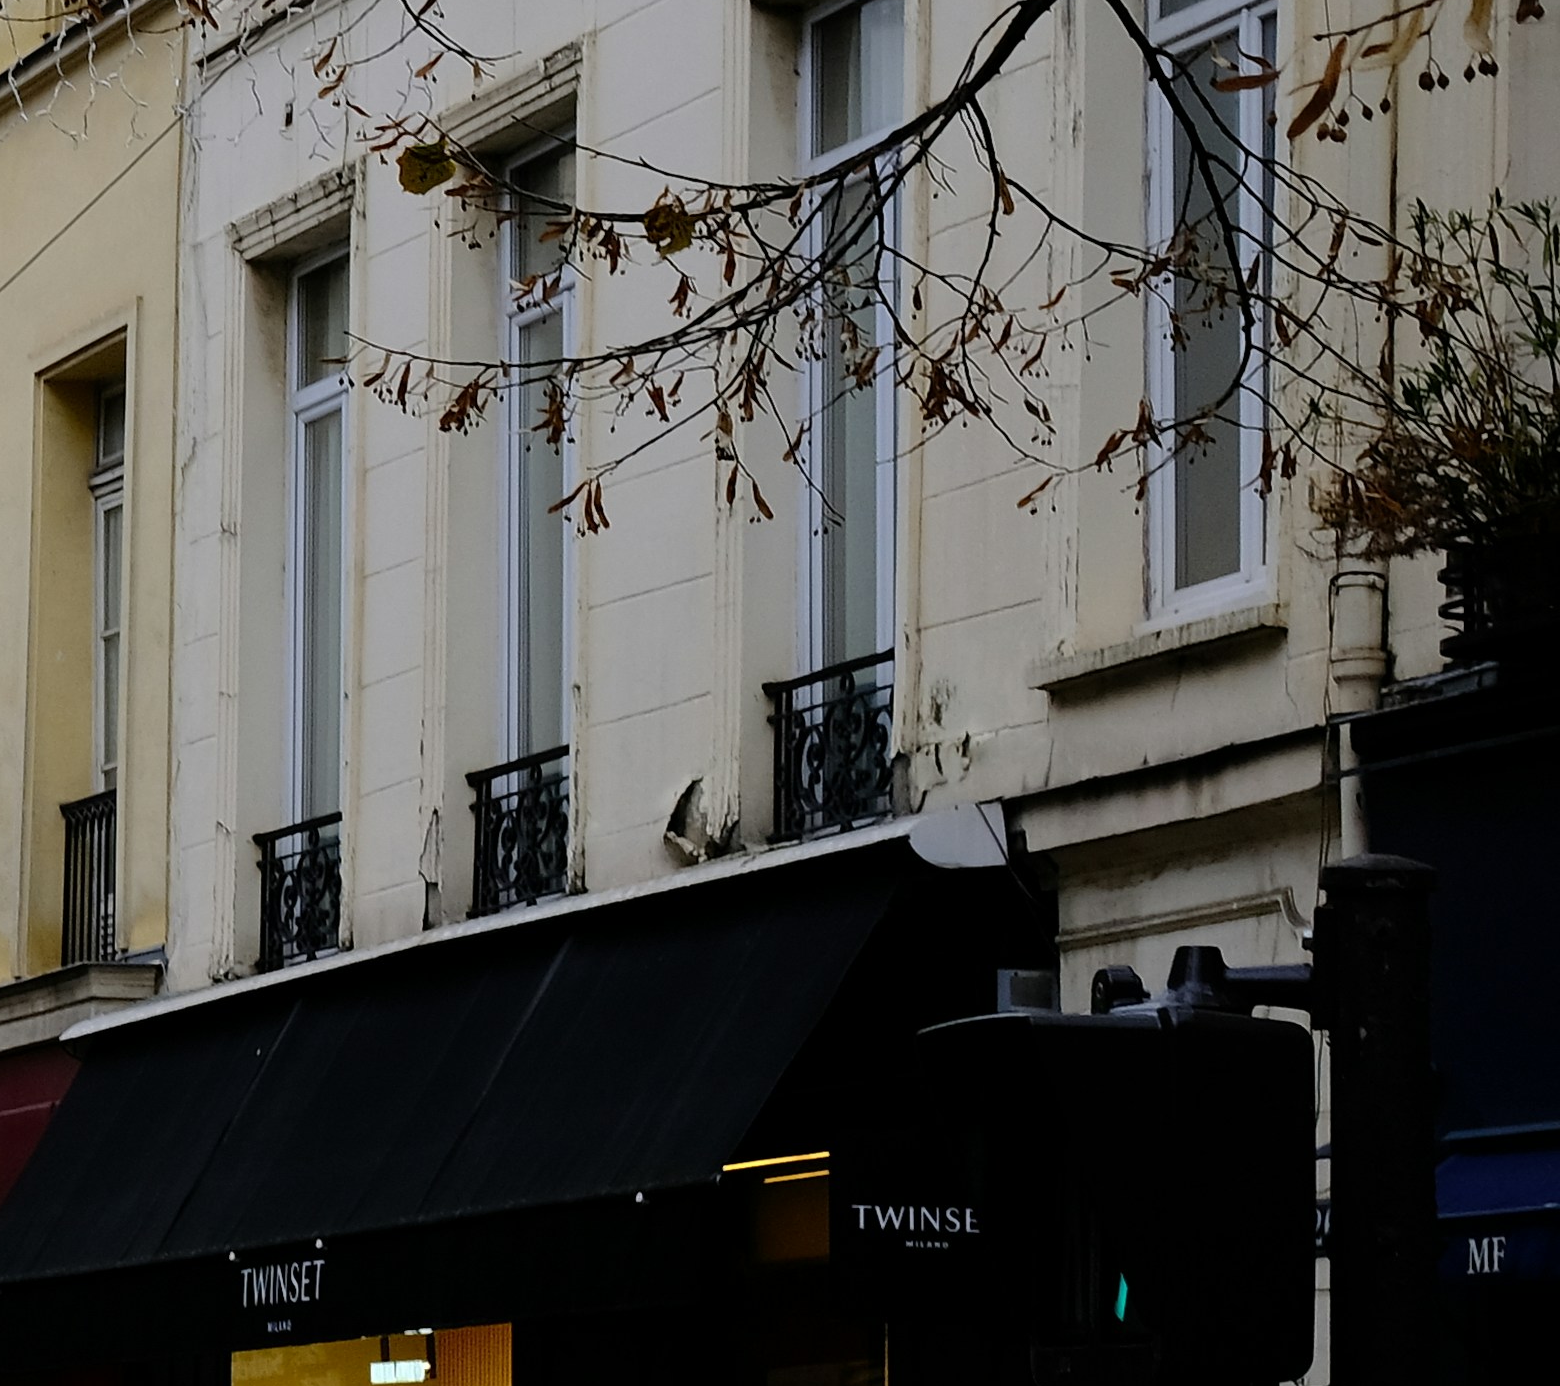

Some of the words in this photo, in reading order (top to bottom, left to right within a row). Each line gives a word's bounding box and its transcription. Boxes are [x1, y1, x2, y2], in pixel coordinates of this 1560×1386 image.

[905, 1239, 949, 1250] MILANO
[1466, 1236, 1507, 1275] MF
[240, 1259, 326, 1309] TWINSET
